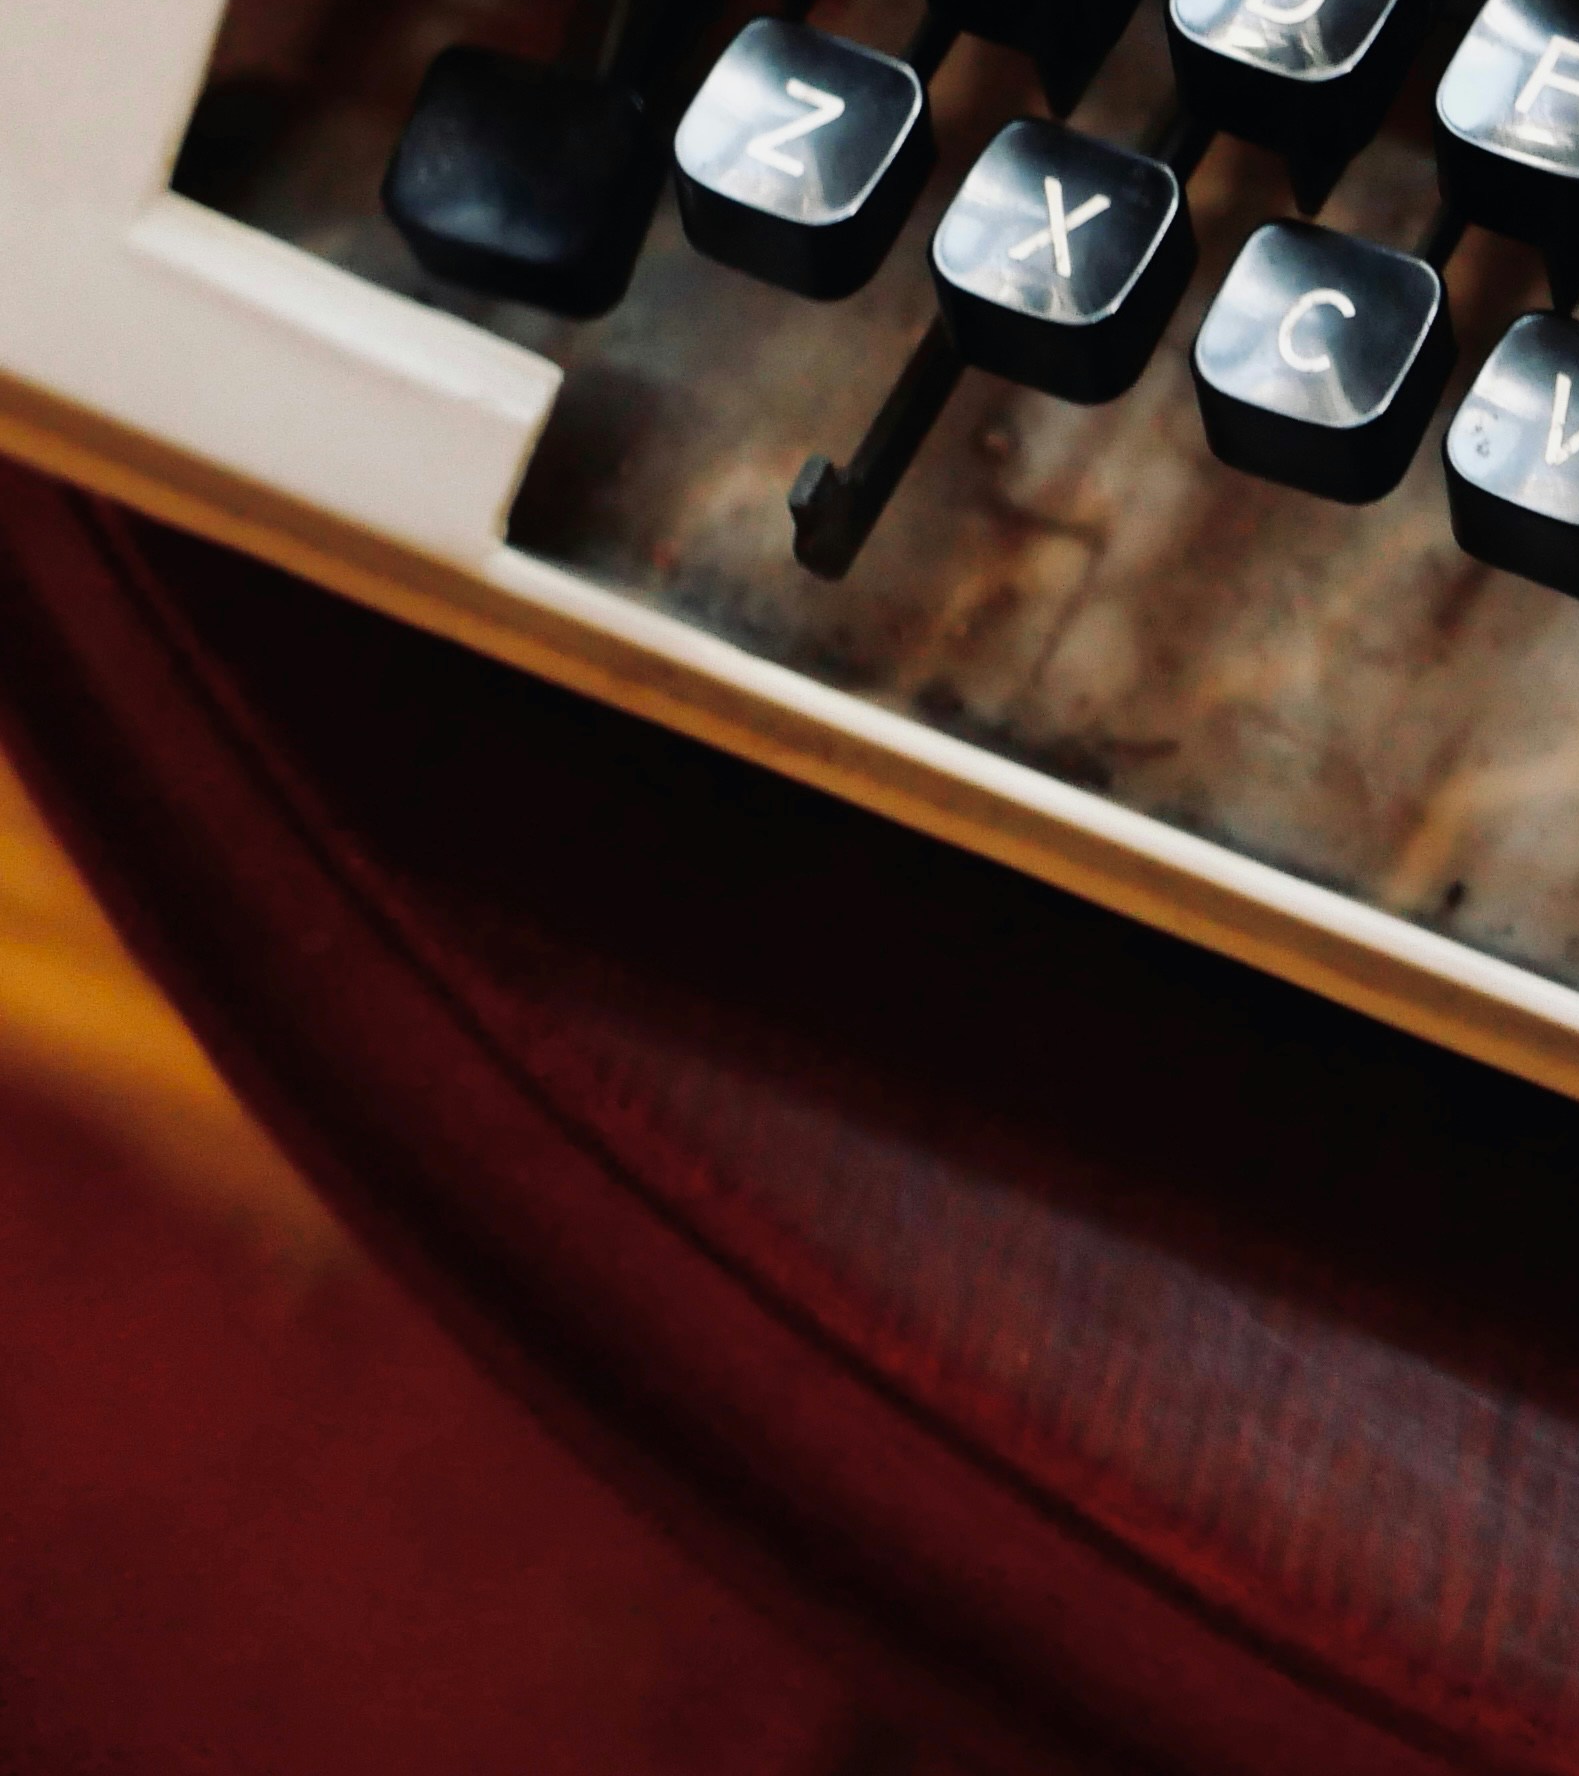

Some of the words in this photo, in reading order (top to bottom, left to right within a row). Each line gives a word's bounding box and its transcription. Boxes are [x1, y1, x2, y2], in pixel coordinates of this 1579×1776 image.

[746, 78, 845, 178] Z
[1008, 175, 1111, 278] X
[1278, 288, 1356, 372] C
